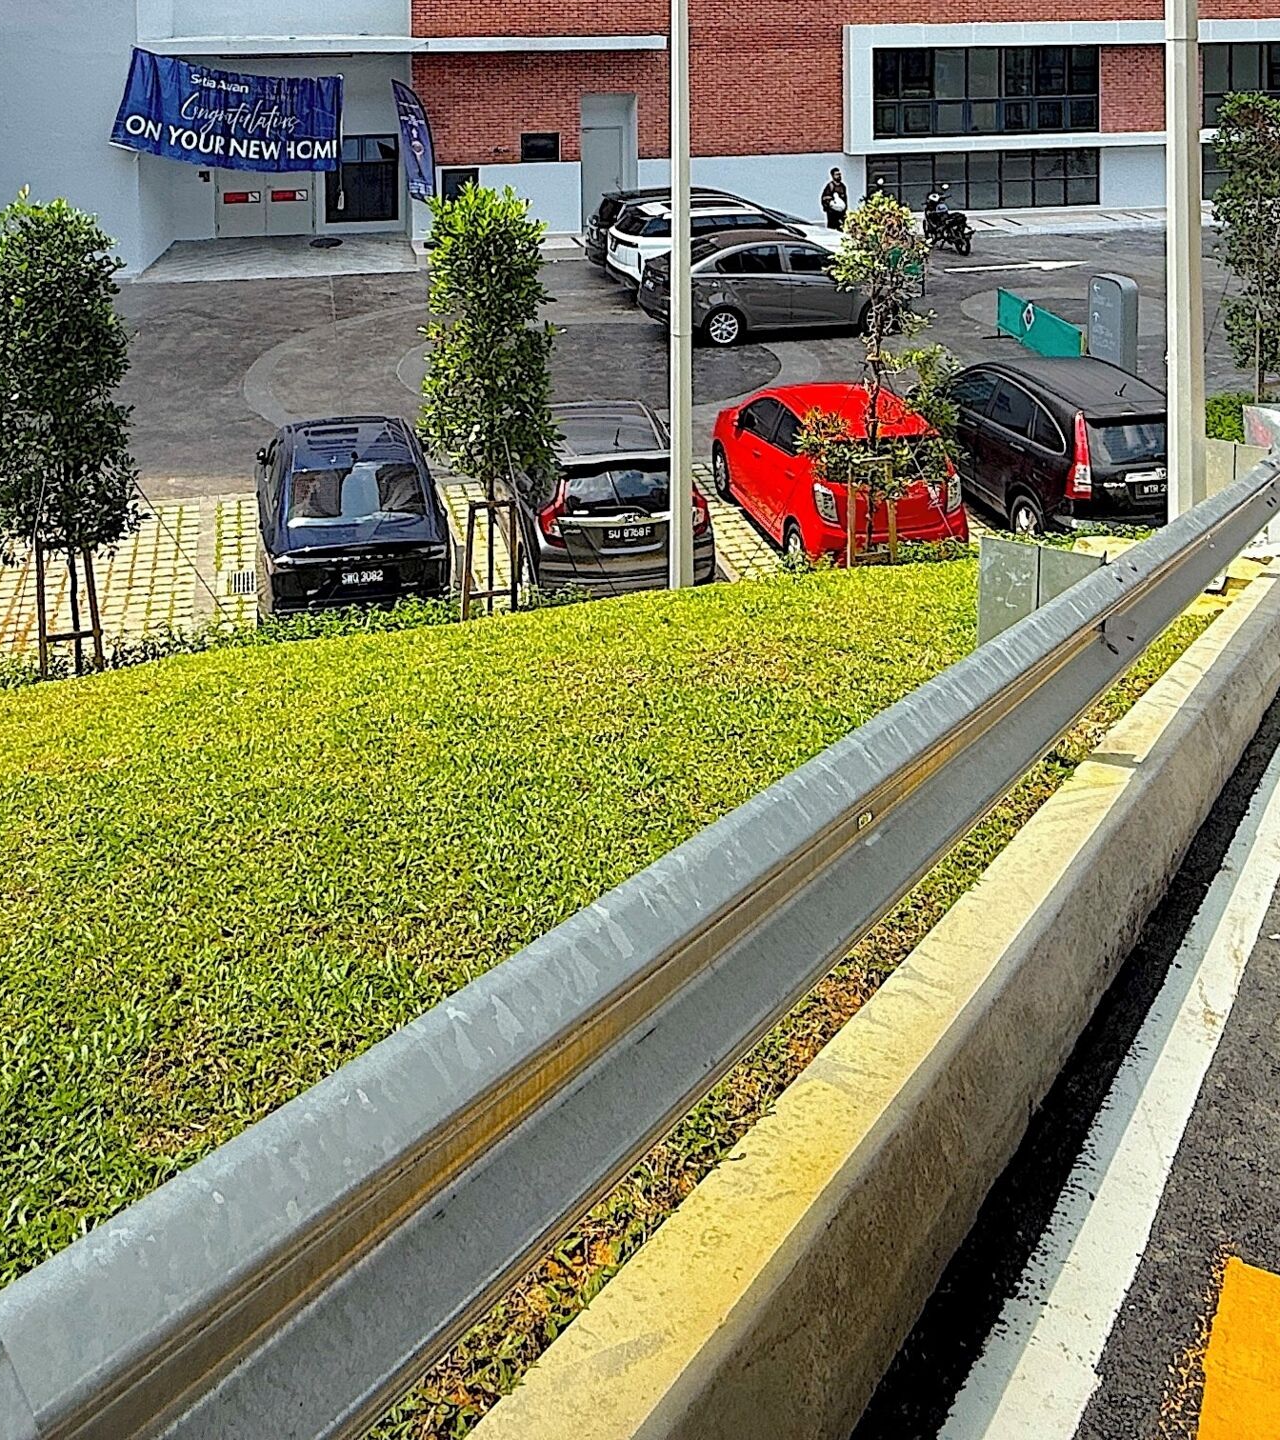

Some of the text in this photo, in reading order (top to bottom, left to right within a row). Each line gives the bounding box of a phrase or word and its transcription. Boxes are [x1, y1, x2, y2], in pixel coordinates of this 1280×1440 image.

[125, 114, 163, 142] ON
[169, 125, 225, 155] YOUR
[229, 139, 282, 160] NEW
